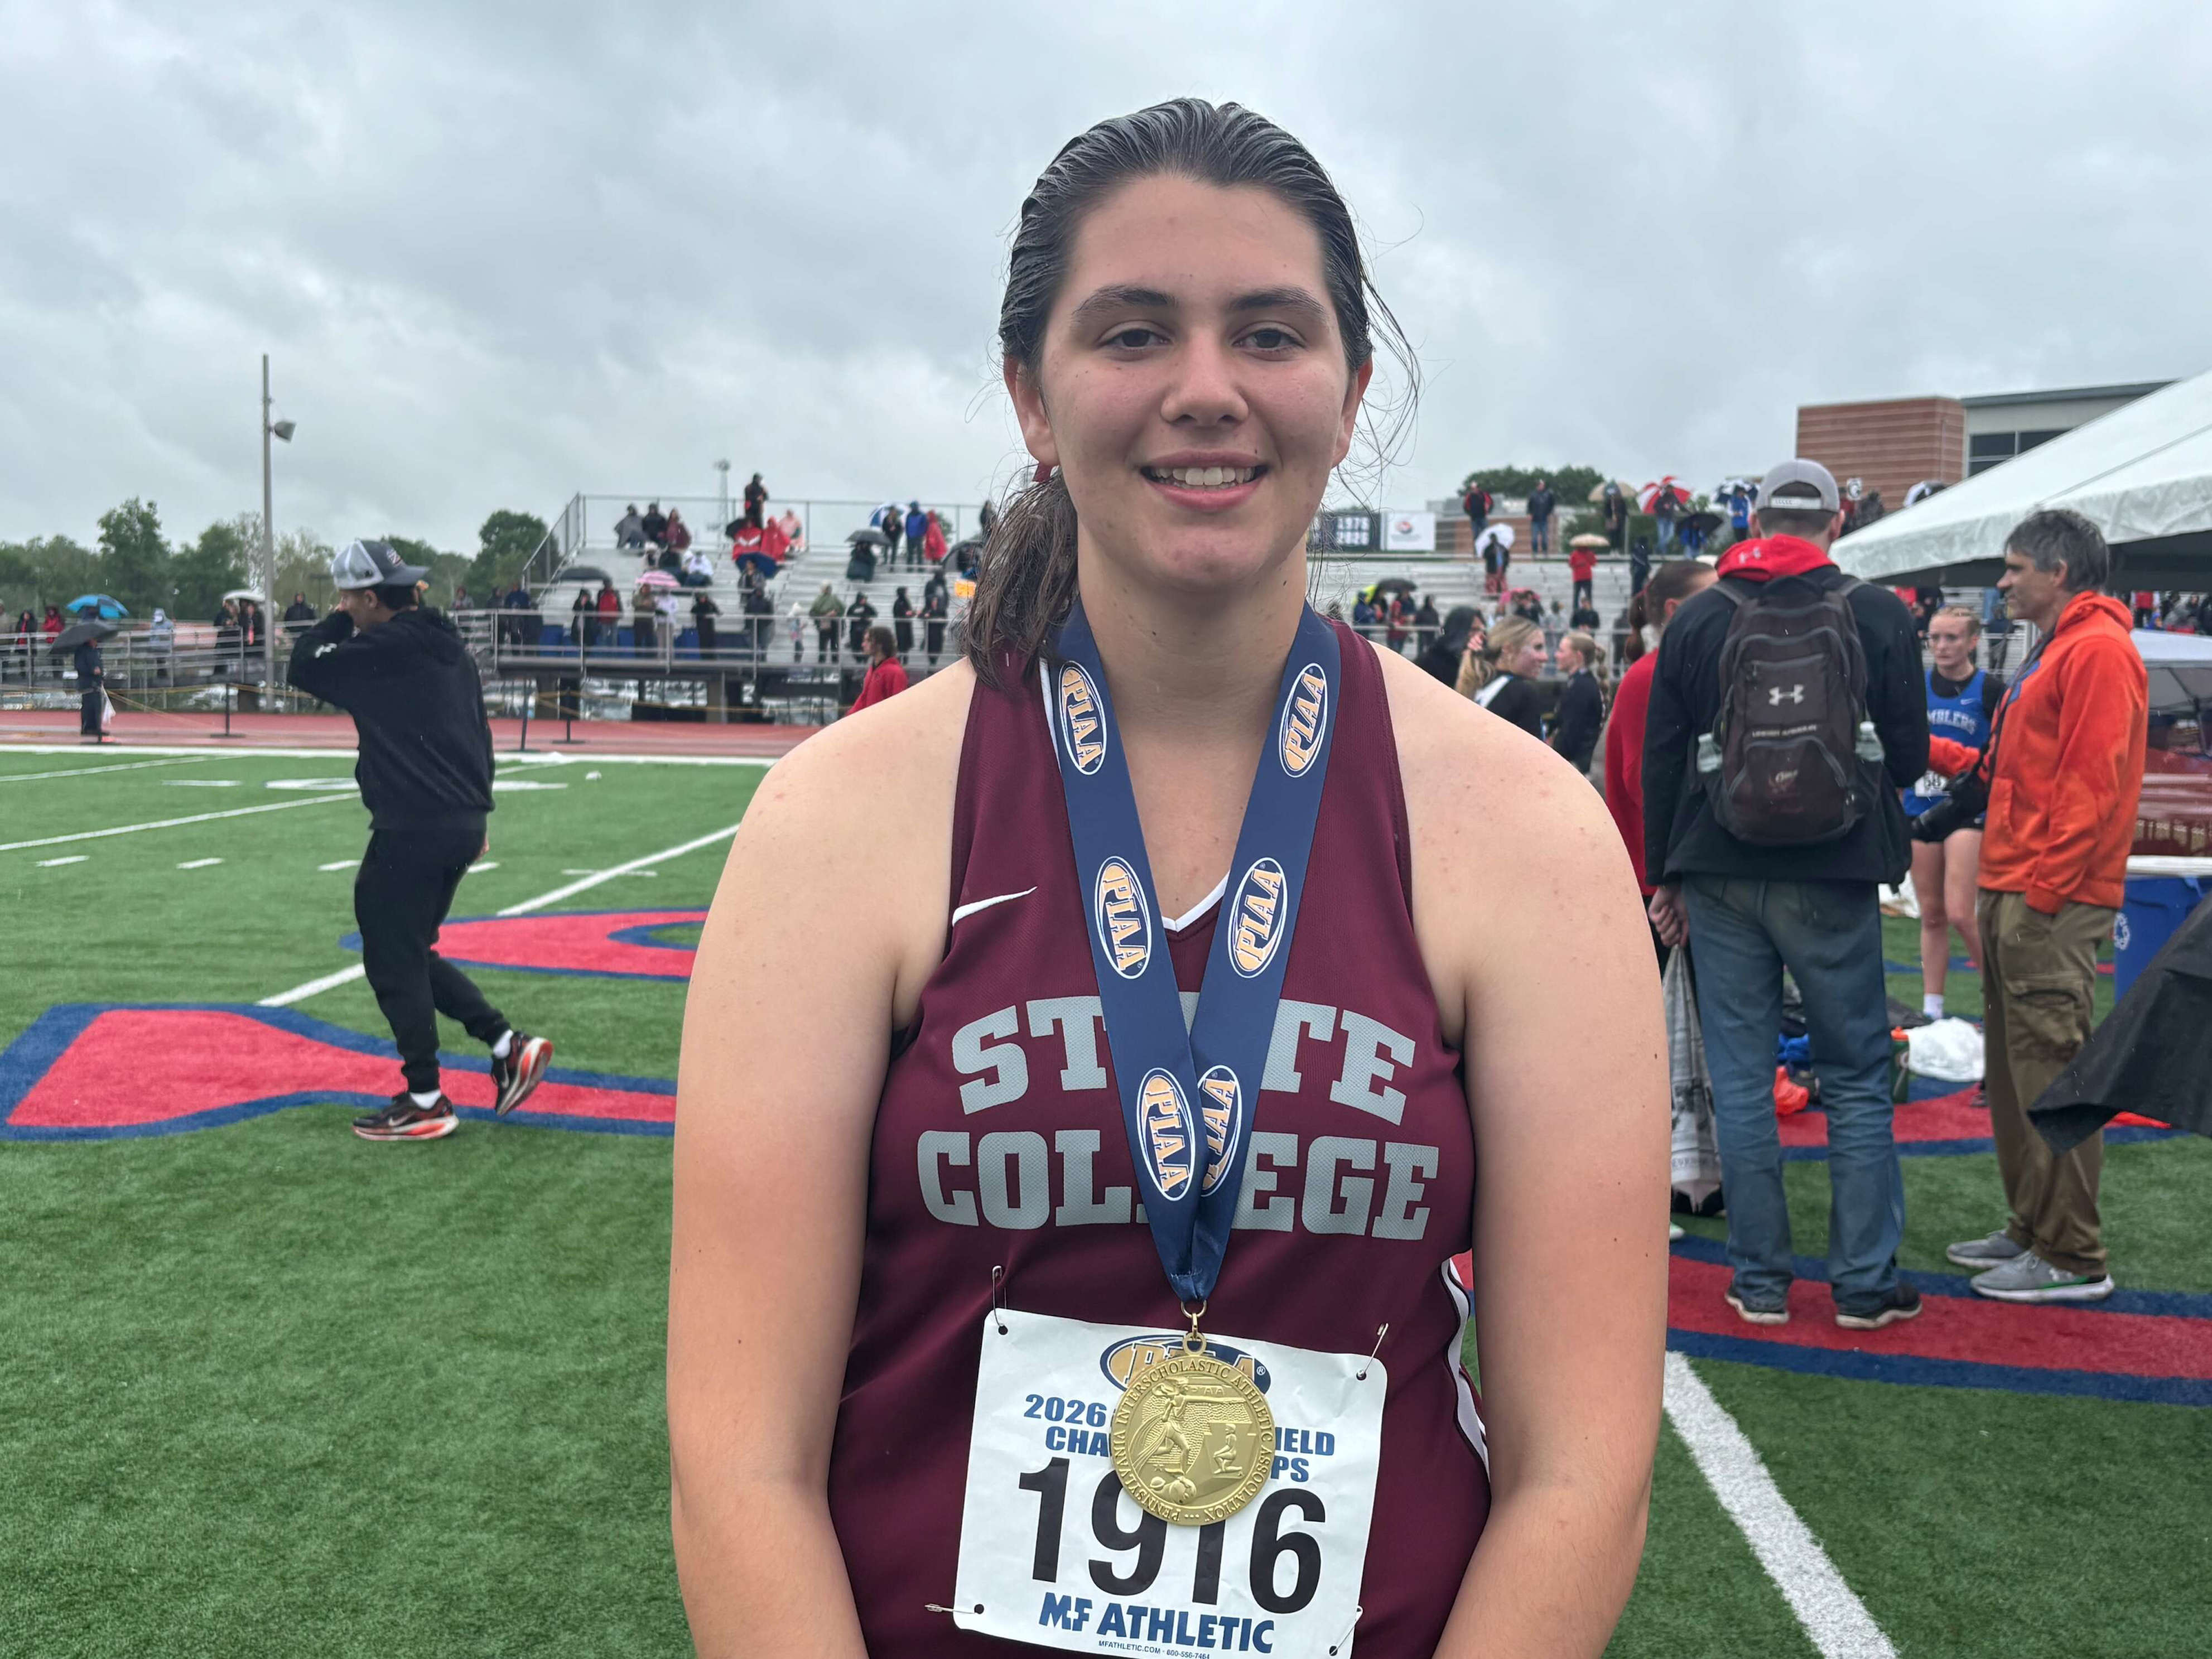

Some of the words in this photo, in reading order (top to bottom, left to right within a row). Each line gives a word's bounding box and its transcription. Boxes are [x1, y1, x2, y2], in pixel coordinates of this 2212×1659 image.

[1062, 669, 1102, 768] PIAA
[1285, 673, 1324, 771] PIAA
[1101, 863, 1147, 971] PIAA
[1233, 868, 1283, 972] PIAA
[952, 992, 1415, 1126] STTE
[1144, 1076, 1189, 1192] PIAA
[917, 1130, 1439, 1240] COLEGE
[1024, 1393, 1107, 1427] 2026
[1275, 1427, 1335, 1455] IELD
[1116, 1360, 1231, 1426] INTERSCHOLASTIC
[1230, 1375, 1273, 1443] ATHLETIC
[1113, 1430, 1182, 1522] PENNSYLVANIA
[1203, 1444, 1273, 1522] ASSOCIATION
[1019, 1457, 1326, 1614] 1916
[1097, 1603, 1274, 1654] ATHLETIC
[1098, 1640, 1160, 1655] MFATHLETIC.COM
